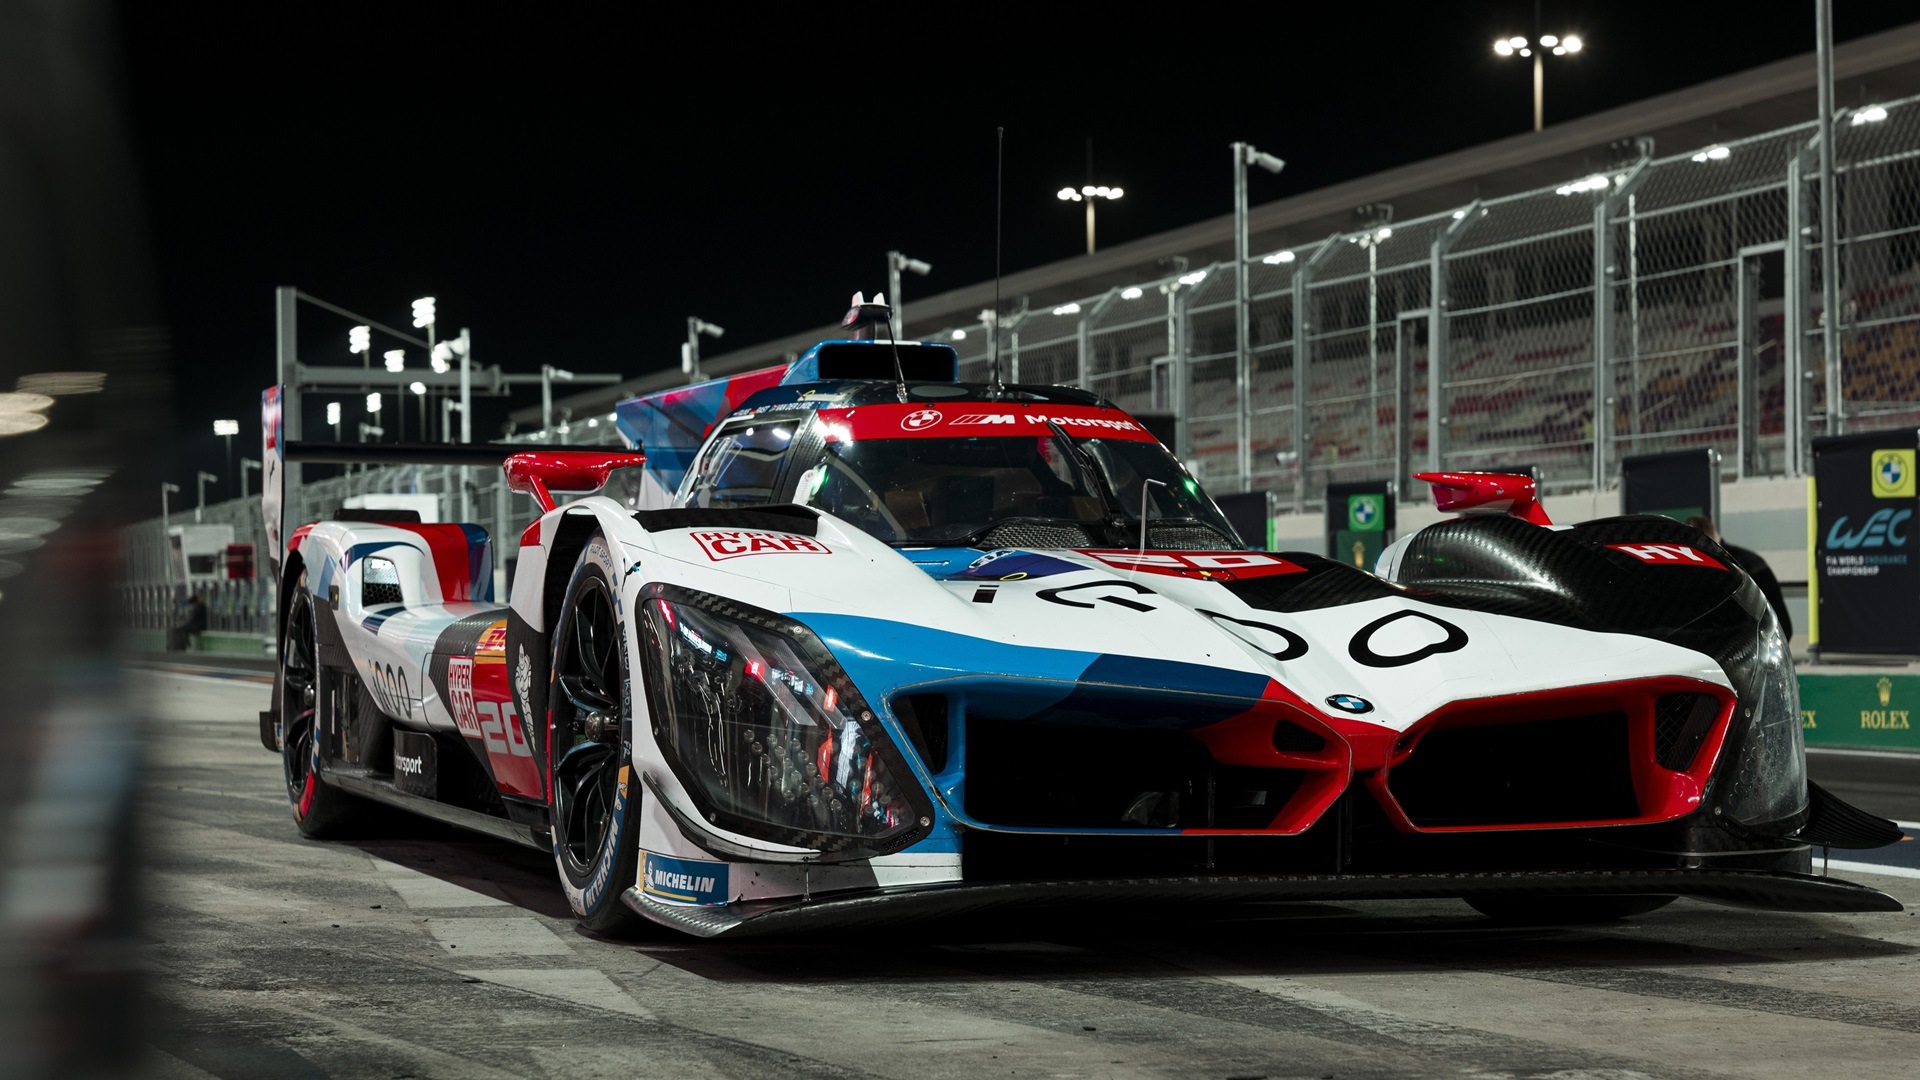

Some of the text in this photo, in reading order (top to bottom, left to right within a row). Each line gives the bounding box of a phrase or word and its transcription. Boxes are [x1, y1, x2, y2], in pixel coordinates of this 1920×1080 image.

[1024, 414, 1142, 431] Motorsport
[1826, 508, 1913, 550] WEC
[711, 539, 820, 555] CAR
[1618, 545, 1704, 562] HY
[1838, 555, 1865, 566] WORLD
[1865, 554, 1908, 565] ENDURANCE
[1826, 566, 1880, 576] CHAMPIONSHIP
[449, 663, 471, 689] HYPER
[450, 689, 479, 731] CAR
[1860, 710, 1910, 729] ROLEX
[476, 701, 533, 757] 20
[585, 816, 619, 909] MICHELIN
[654, 869, 716, 893] MICHELIN
